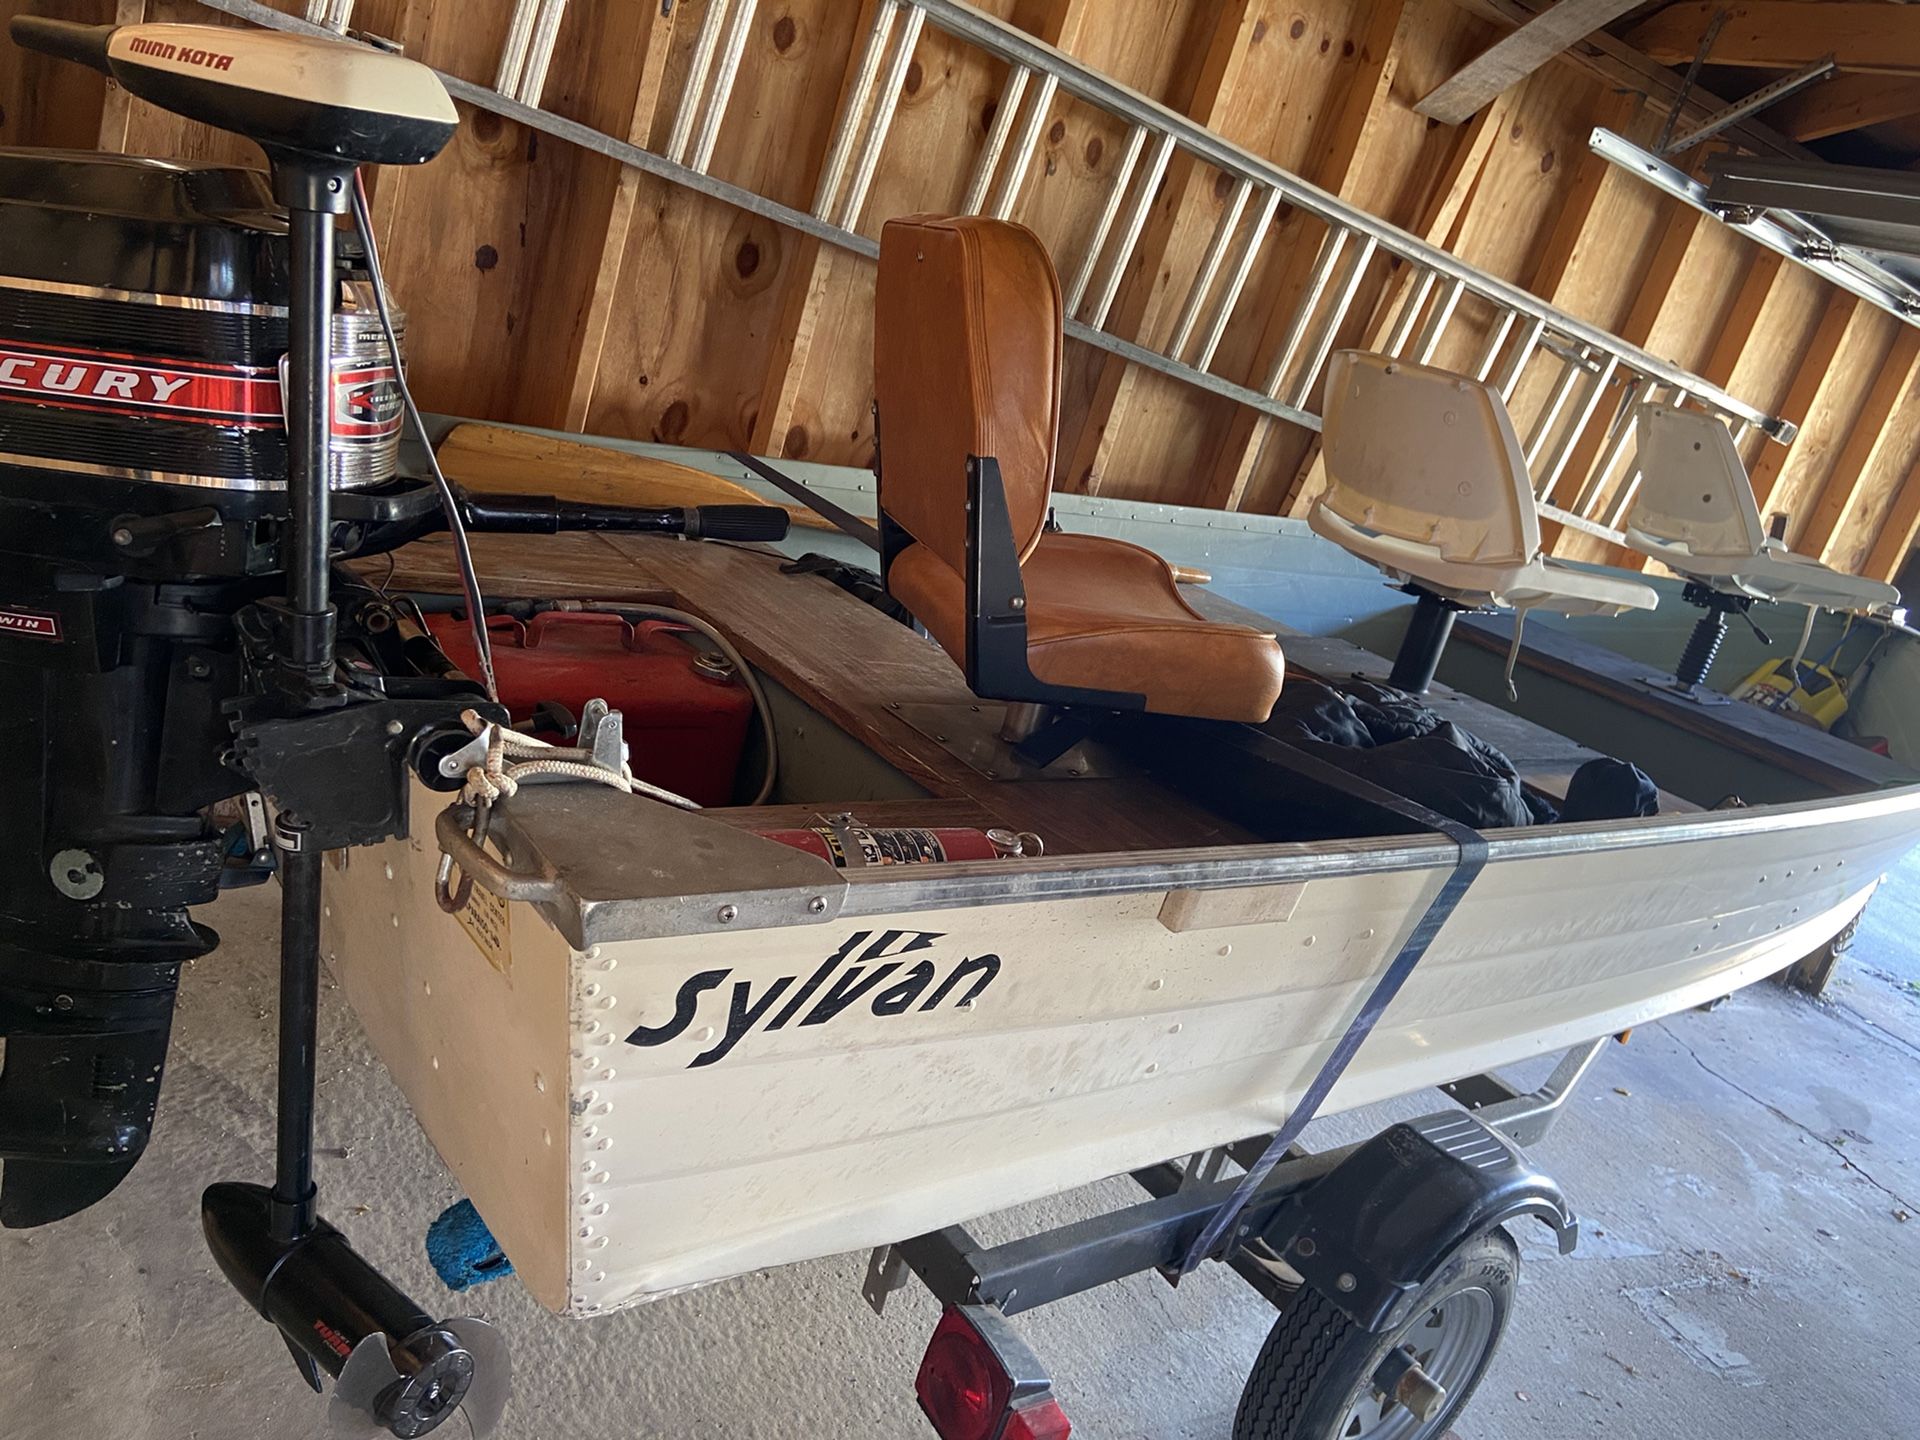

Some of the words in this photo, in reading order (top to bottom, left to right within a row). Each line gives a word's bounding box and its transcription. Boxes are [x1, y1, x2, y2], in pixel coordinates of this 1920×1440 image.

[129, 37, 177, 59] MINN
[176, 47, 234, 71] KOTA
[0, 358, 191, 402] CURY
[624, 929, 1002, 1069] Sylvan
